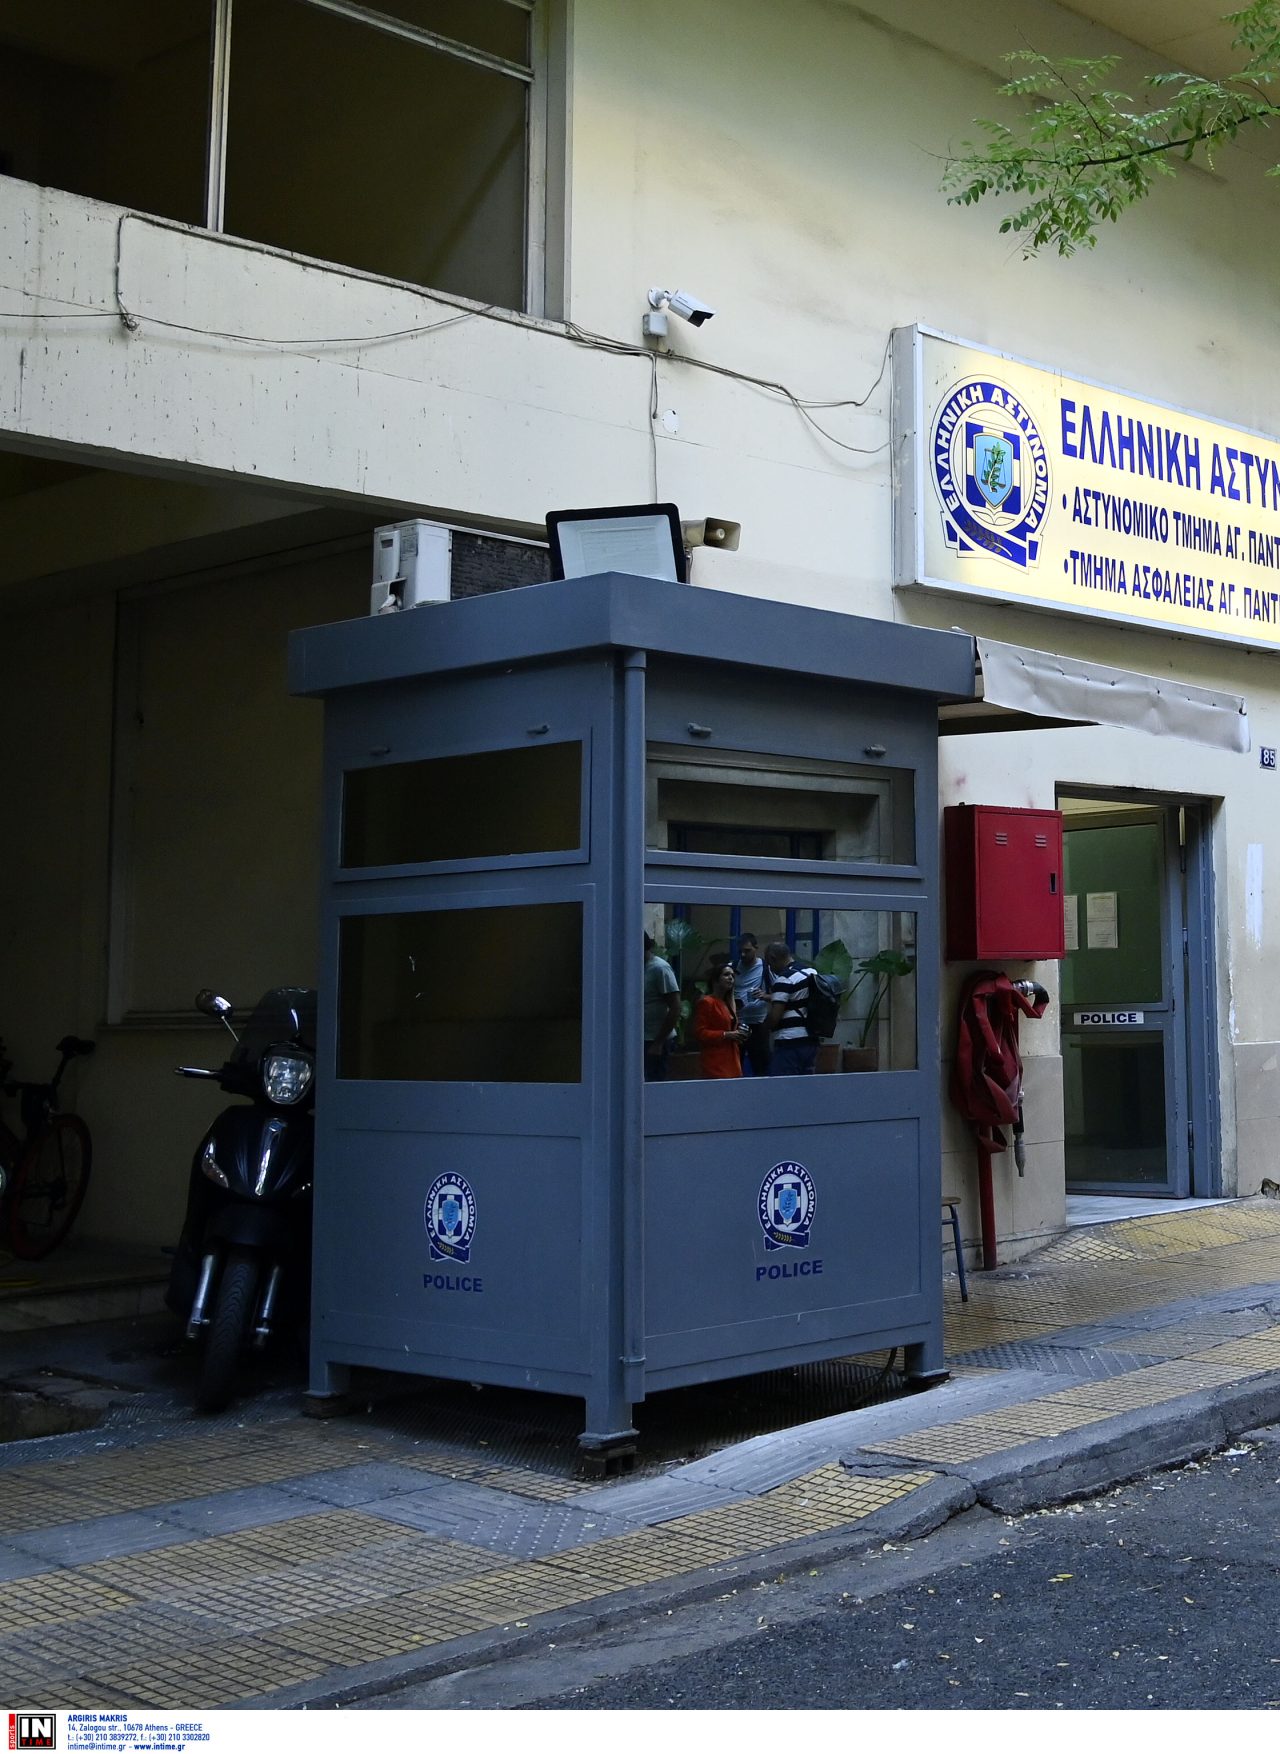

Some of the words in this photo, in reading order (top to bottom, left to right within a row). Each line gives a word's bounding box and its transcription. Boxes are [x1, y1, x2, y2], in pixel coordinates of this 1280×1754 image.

[937, 385, 984, 512] ΕΛΛΗΝΙΚΗ
[990, 387, 1048, 529] ΑΣΤΥΝΟΜΙΑ
[1060, 398, 1201, 491] ΕΛΛΗΝΙΚΗ
[1072, 486, 1169, 543] ΑΣΤΥΝΟΜΙΚΟ
[1173, 511, 1222, 556] ΤΜΗΜΑ
[1070, 550, 1127, 595] ΤΜΗΜΑ
[1132, 563, 1214, 612] ΑΣΦΑΛΕΙΑΣ
[1263, 748, 1276, 766] 85
[1080, 1012, 1138, 1024] POLICE
[423, 1273, 484, 1293] POLICE
[755, 1260, 824, 1282] POLICE
